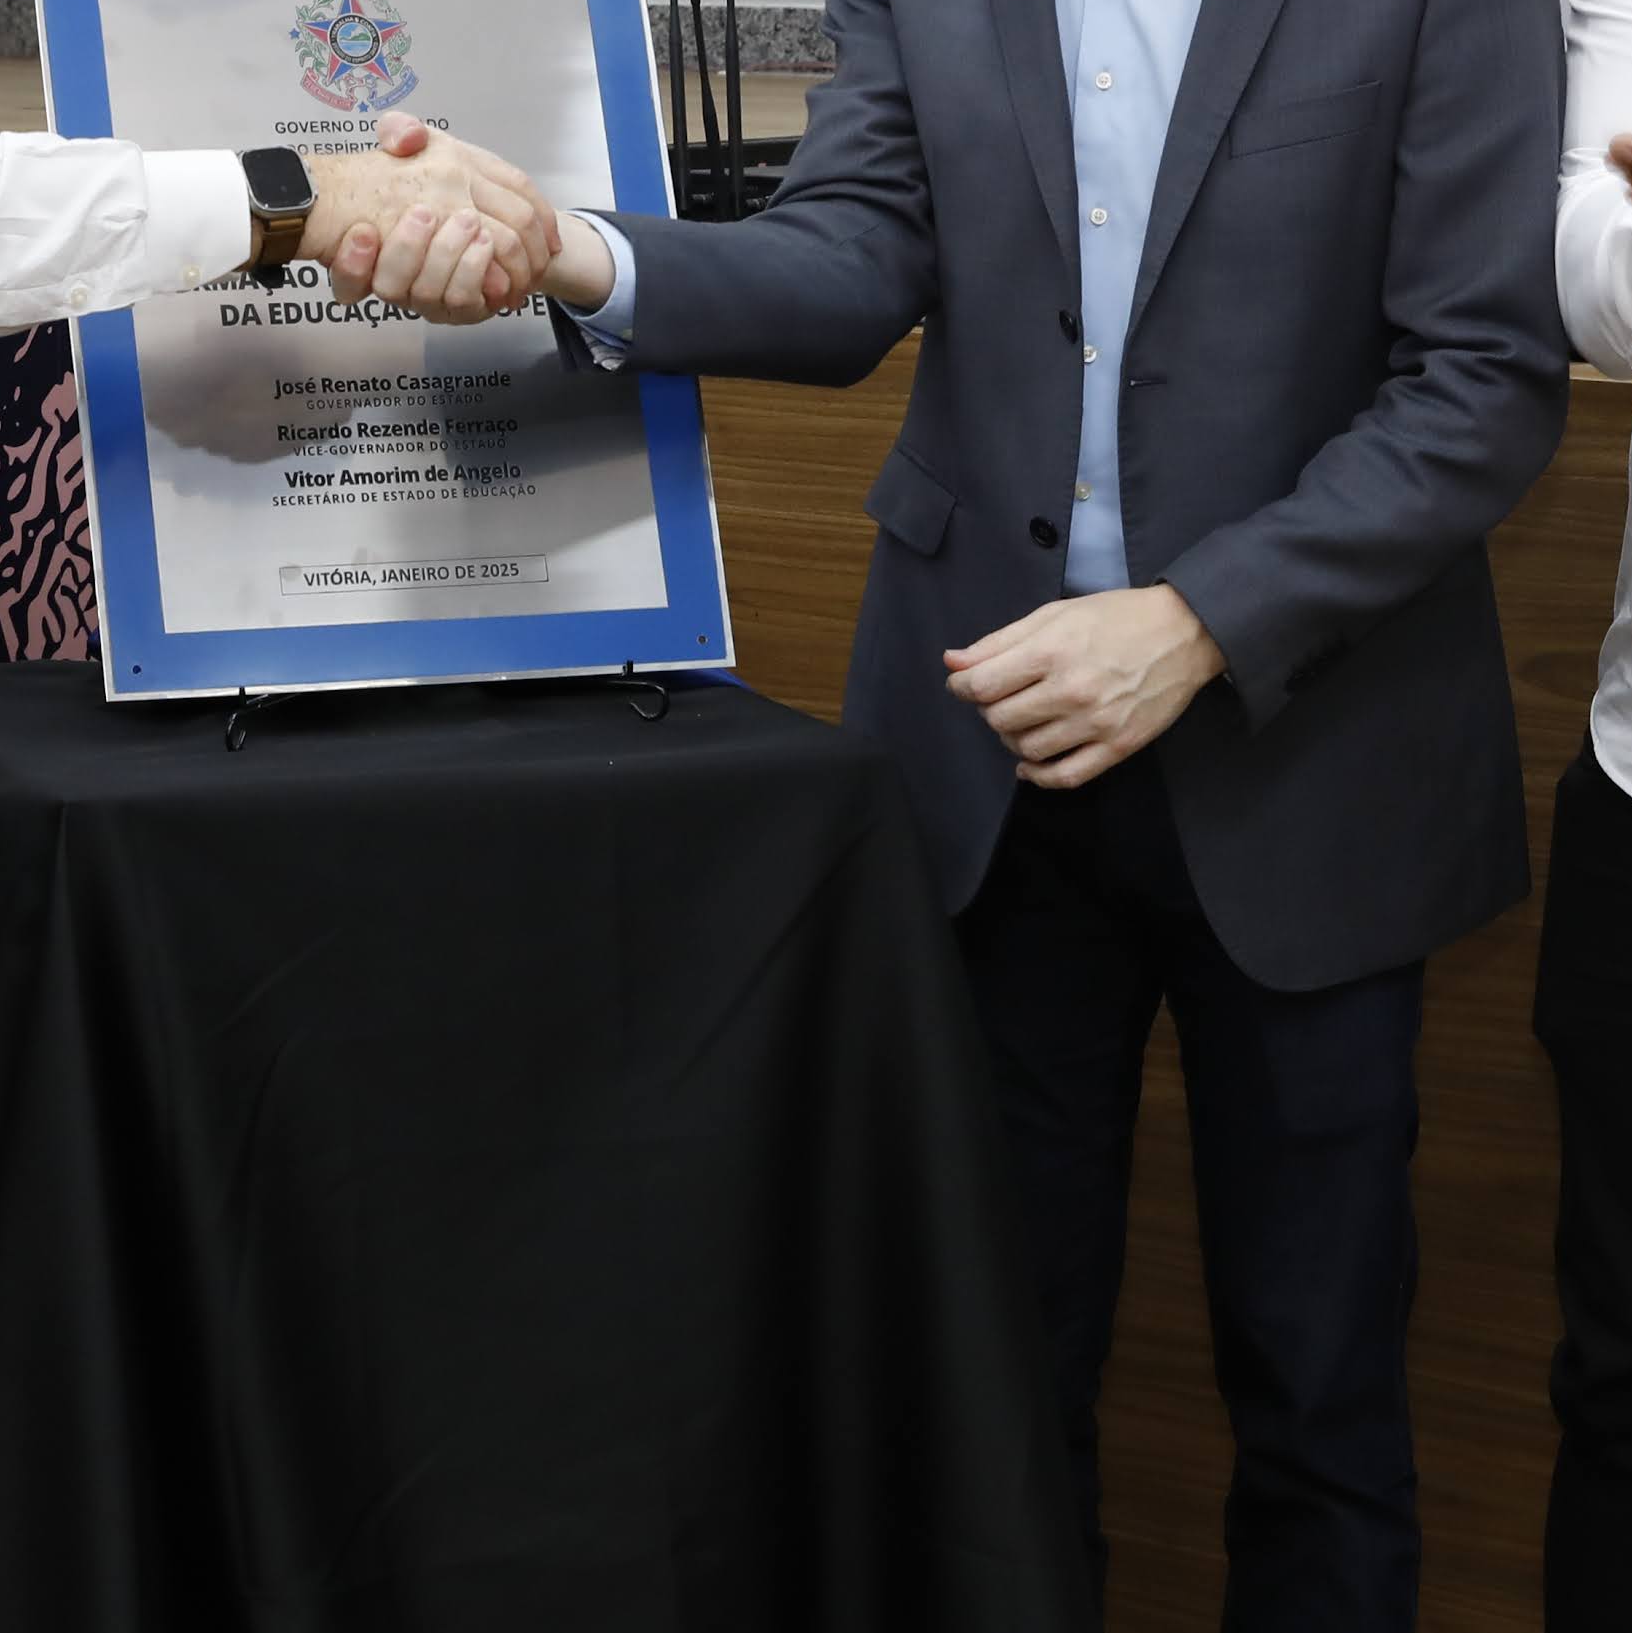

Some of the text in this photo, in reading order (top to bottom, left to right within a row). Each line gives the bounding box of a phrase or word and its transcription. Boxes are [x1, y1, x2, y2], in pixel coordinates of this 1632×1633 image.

[275, 120, 354, 134] GOVERNO
[314, 140, 380, 156] ESPÍRIT
[220, 304, 262, 326] DA
[274, 371, 511, 399] José Renato Casagrande
[306, 393, 483, 410] GOVERNADOR DO ESTADO
[277, 417, 518, 441] Ricardo Rezende Ferraço
[294, 438, 506, 456] VICE-GOVERNADOR DO ESTADO
[284, 461, 521, 488] Vitor Amorim de Angelo
[272, 484, 536, 506] SECRETÁRIO DE ESTADO DE EDUCAÇÃO
[304, 562, 519, 586] VITÓRIA, JANEIRO DE 2025
